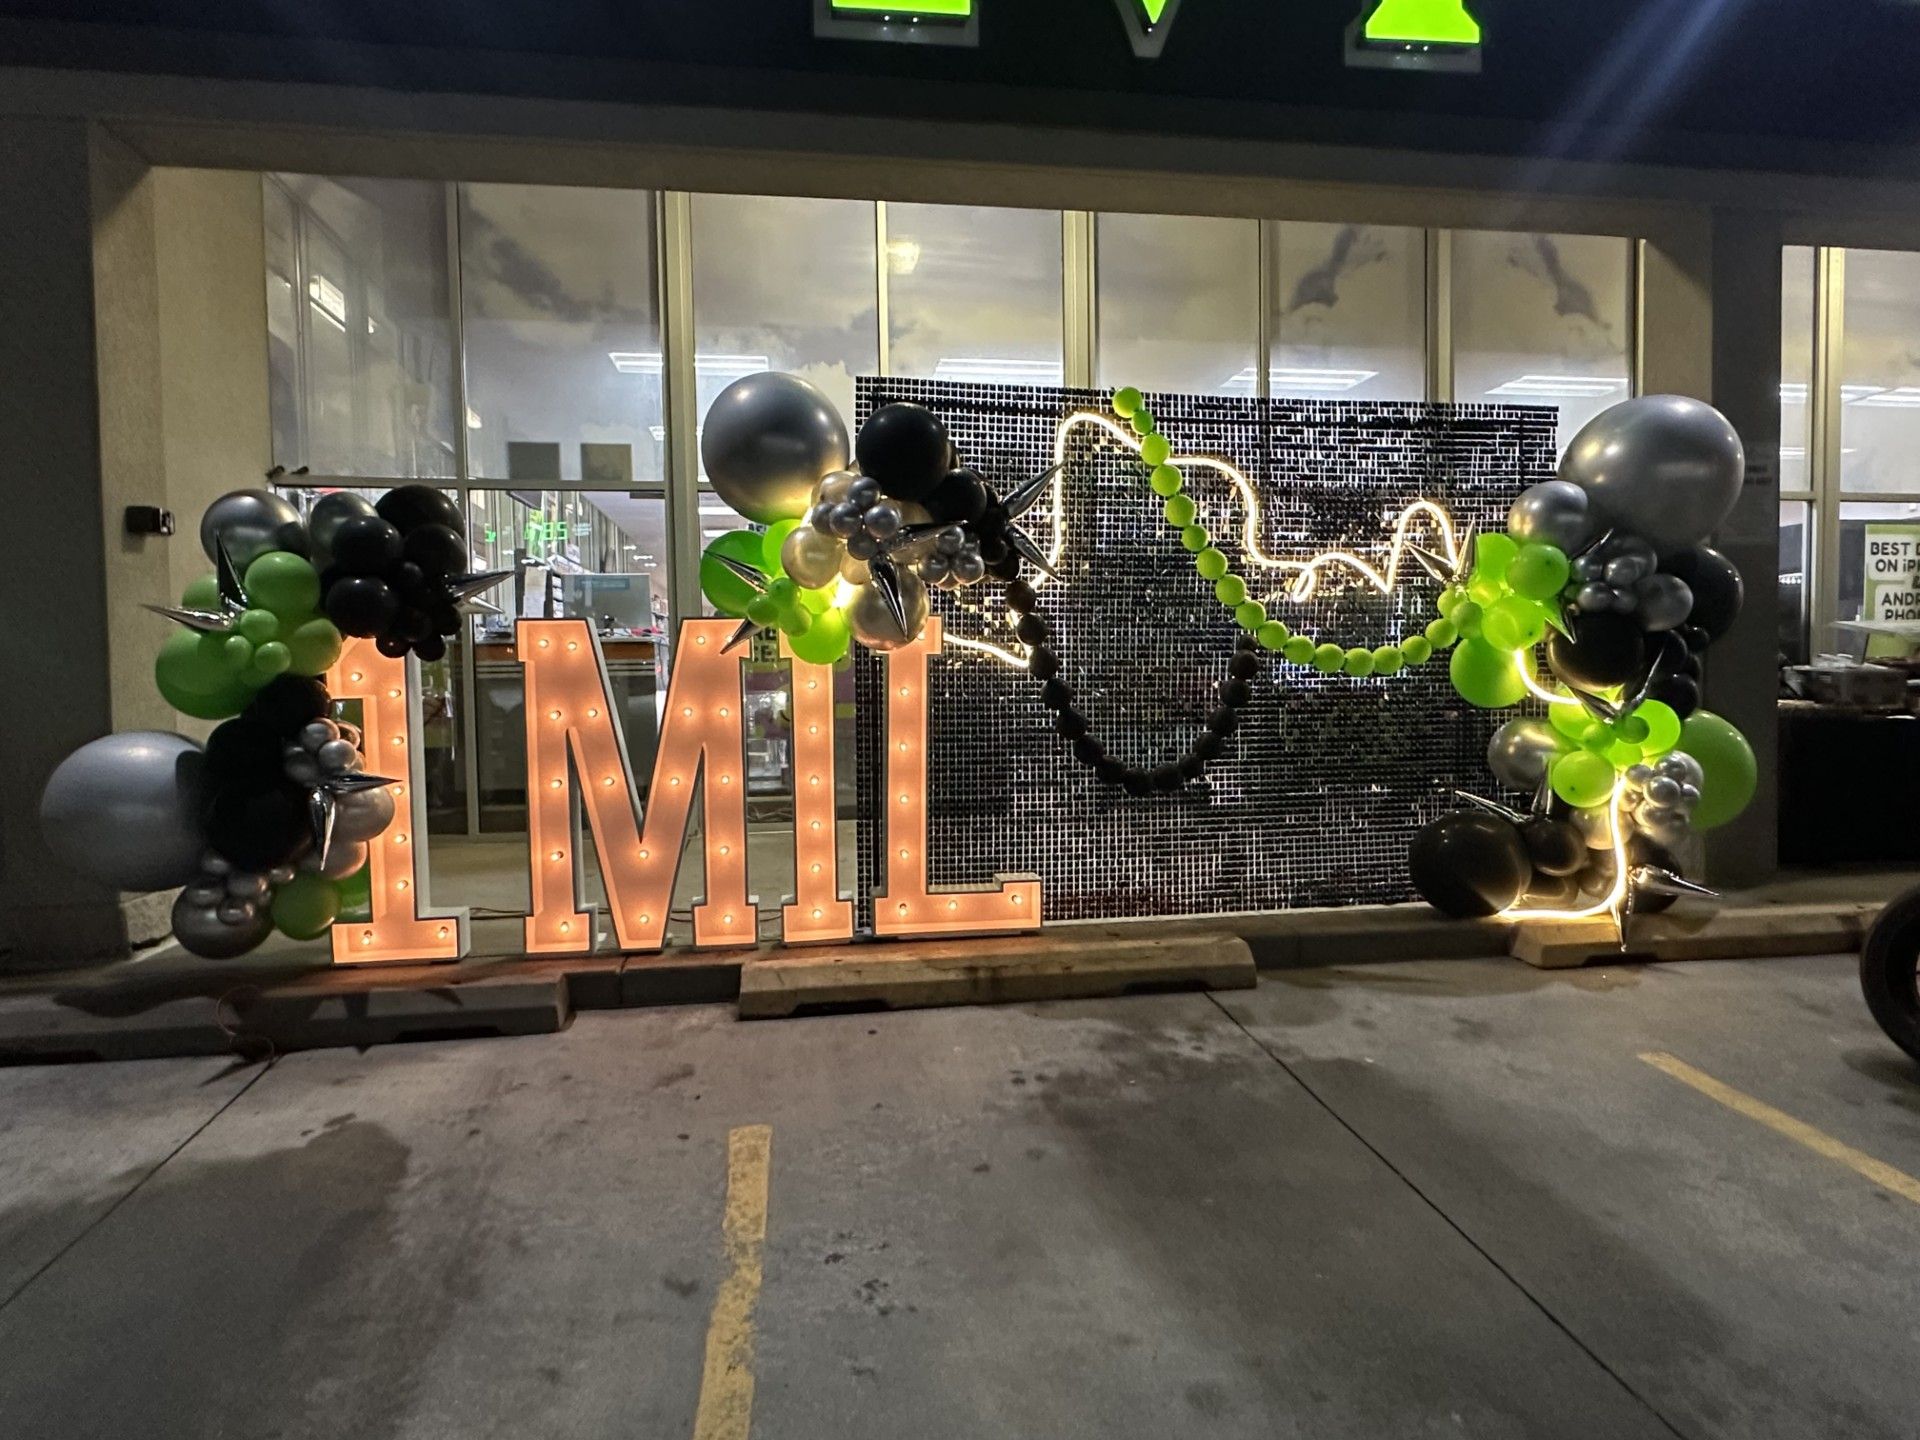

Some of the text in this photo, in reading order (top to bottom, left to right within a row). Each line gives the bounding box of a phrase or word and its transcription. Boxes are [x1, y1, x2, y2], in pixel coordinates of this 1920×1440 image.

[1870, 542, 1911, 556] BEST
[1875, 559, 1898, 572] ON
[1885, 608, 1920, 620] PHO
